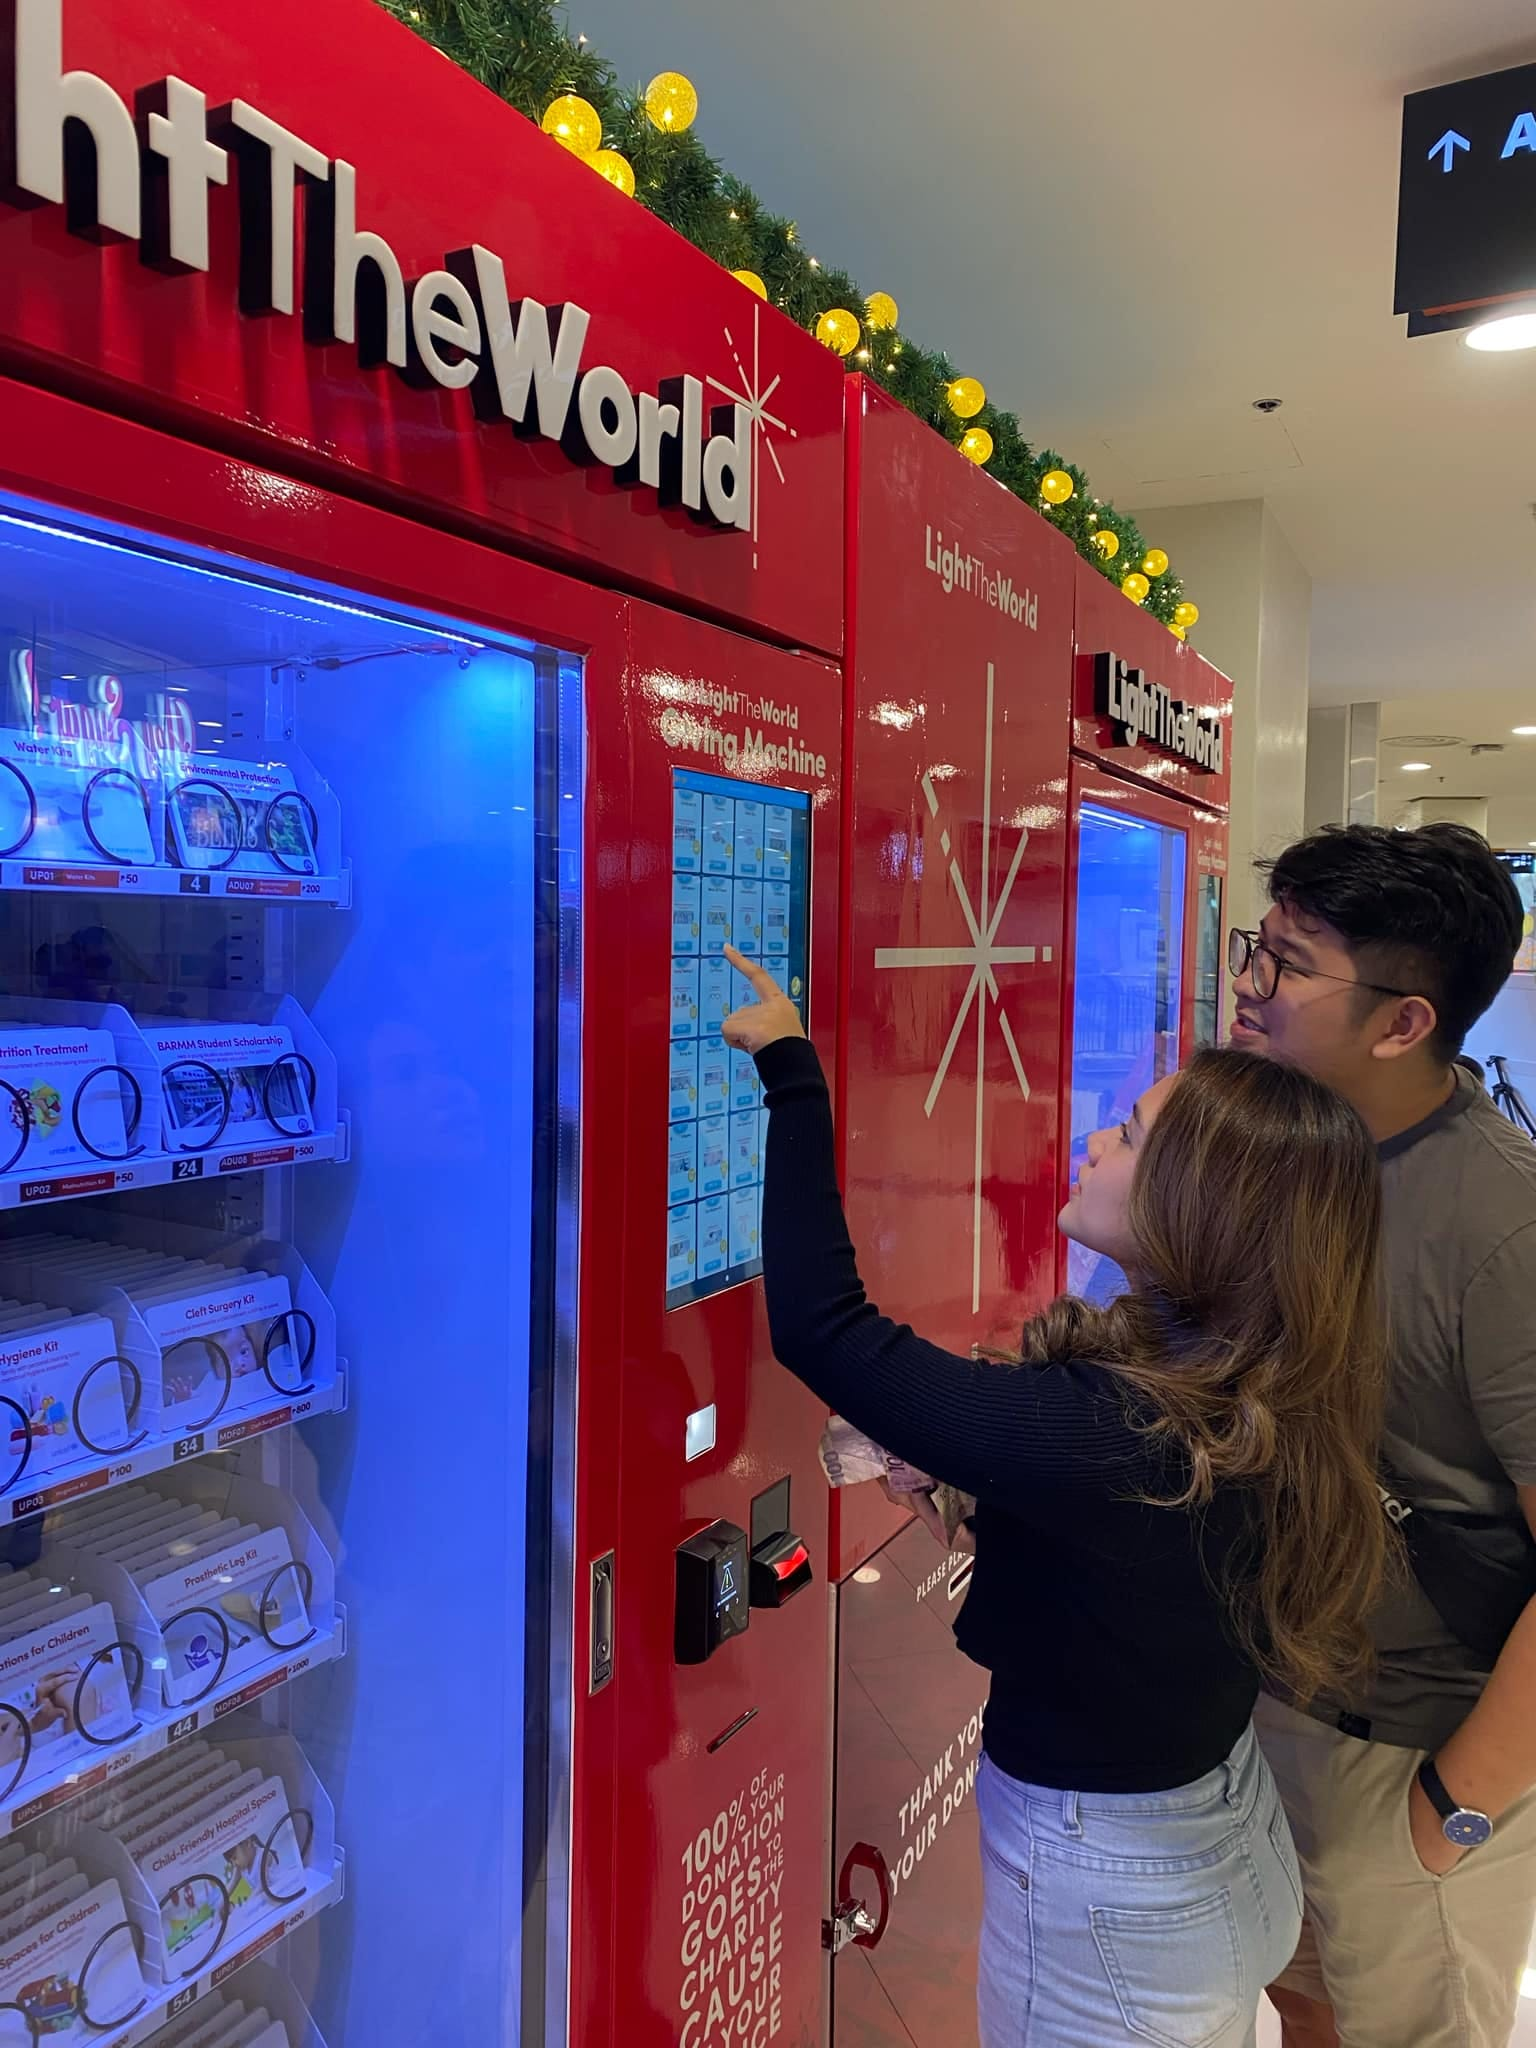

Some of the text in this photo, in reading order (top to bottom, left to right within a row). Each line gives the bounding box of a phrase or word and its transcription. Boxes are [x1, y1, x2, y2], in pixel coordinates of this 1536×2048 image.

[925, 524, 1038, 632] LightTheWorld
[1108, 650, 1224, 776] LightTheWorld
[13, 740, 50, 755] Water
[744, 726, 827, 778] Machine
[180, 761, 281, 785] Environmental Protection
[30, 870, 54, 881] UP01
[190, 876, 201, 891] 4
[33, 1043, 89, 1056] Treatment
[157, 1034, 283, 1052] BARMM Student Scholarship
[178, 1159, 198, 1177] 24
[25, 1184, 51, 1197] UP02
[185, 1293, 255, 1320] Cleft Surgery Kit
[0, 1340, 59, 1367] Hygiene Kit
[180, 1437, 198, 1456] 34
[19, 1495, 44, 1512] UP03
[184, 1548, 257, 1588] Prosthetic Leg Kit
[916, 1551, 967, 1603] PLEASE PLA
[31, 1644, 45, 1657] for
[47, 1625, 90, 1649] Children
[173, 1716, 193, 1737] 44
[750, 1772, 785, 1819] YOUR
[898, 1743, 953, 1838] THANK
[152, 1824, 216, 1872] Child-Friendly
[215, 1802, 251, 1834] Hospital
[250, 1789, 277, 1811] Space
[681, 1767, 768, 1885] 100% OF
[889, 1758, 980, 1897] YOUR DON
[681, 1796, 785, 1925] DONATION
[763, 1847, 785, 1882] THE
[681, 1832, 782, 1968] GOES TO
[0, 1902, 100, 1970] Spaces for Children
[679, 1869, 785, 2011] CHARITY
[679, 1911, 783, 2048] CAUSE
[173, 1988, 192, 2012] 54
[720, 1962, 781, 2048] YOUR
